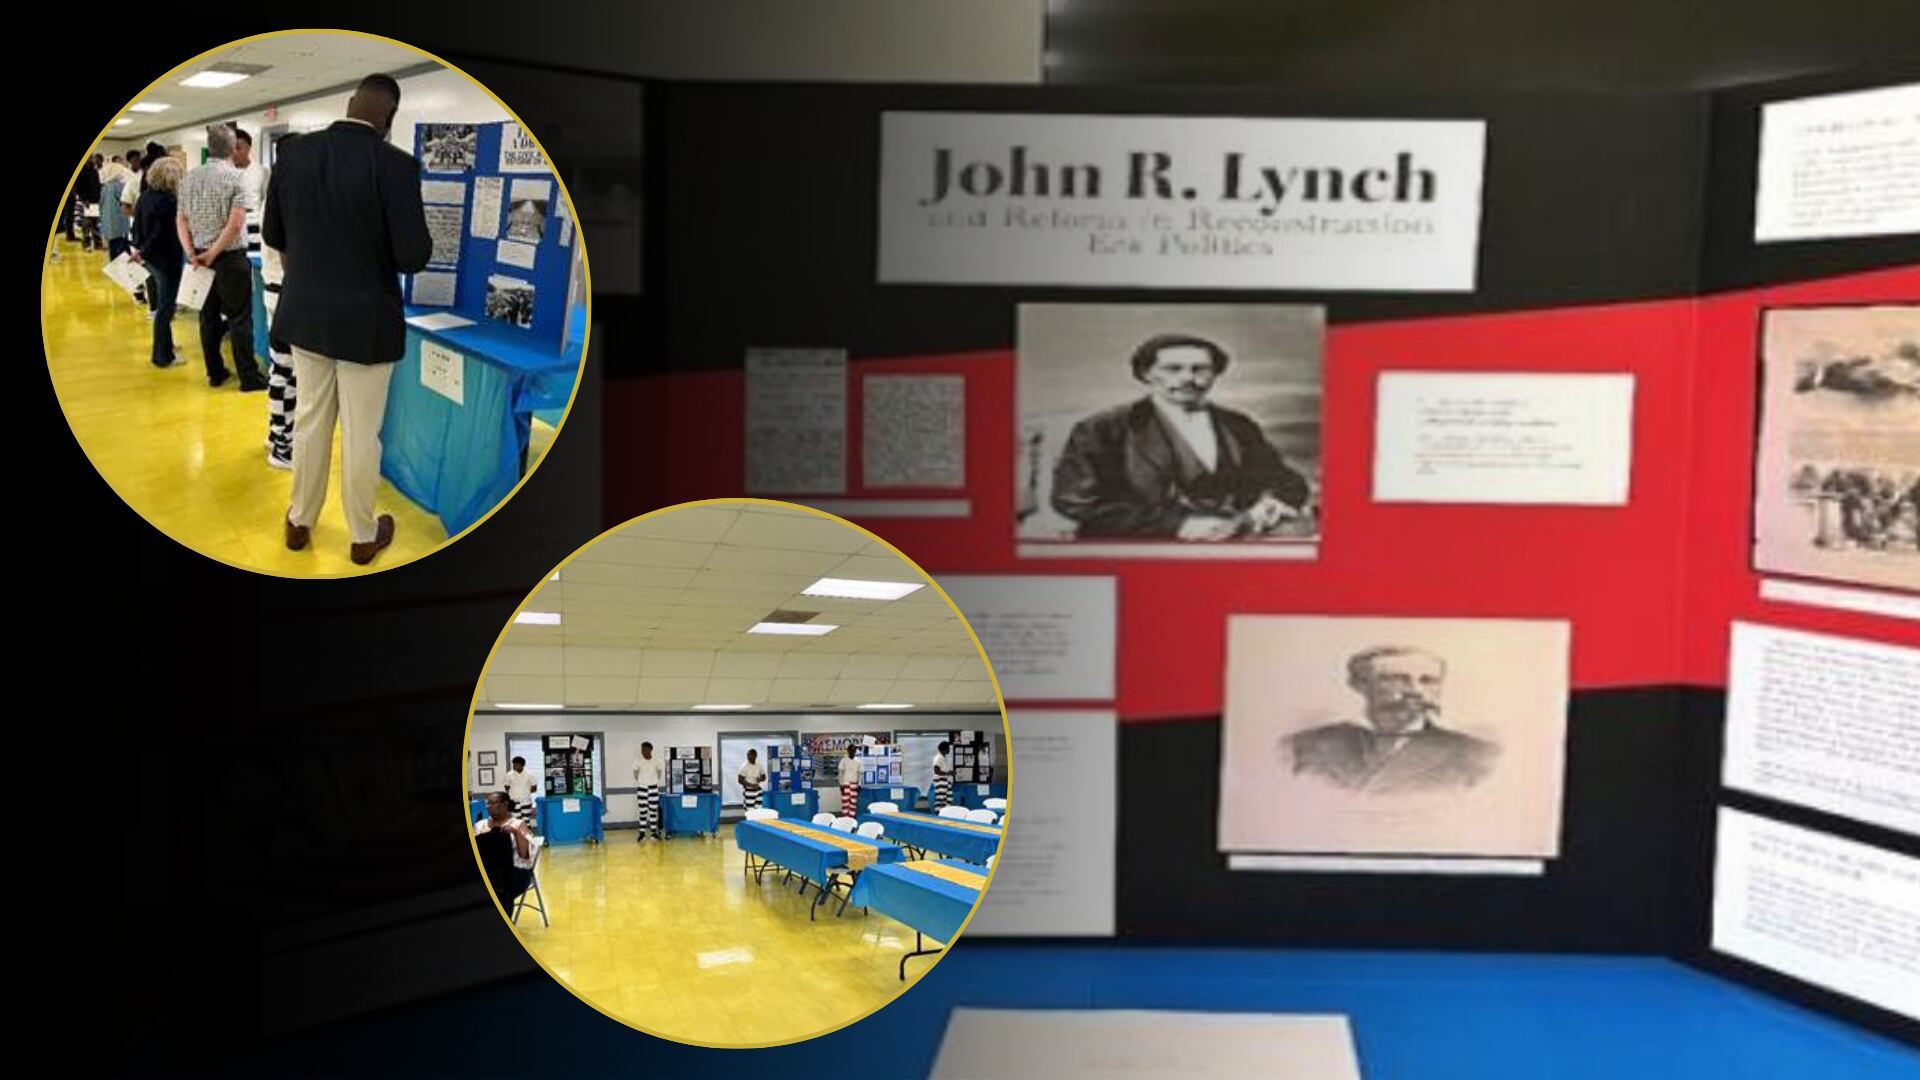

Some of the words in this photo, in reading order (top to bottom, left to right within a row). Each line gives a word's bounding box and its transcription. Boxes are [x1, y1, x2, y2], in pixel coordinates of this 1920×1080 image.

[918, 145, 1101, 206] John
[1128, 152, 1197, 199] R.
[1220, 152, 1437, 216] Lynch
